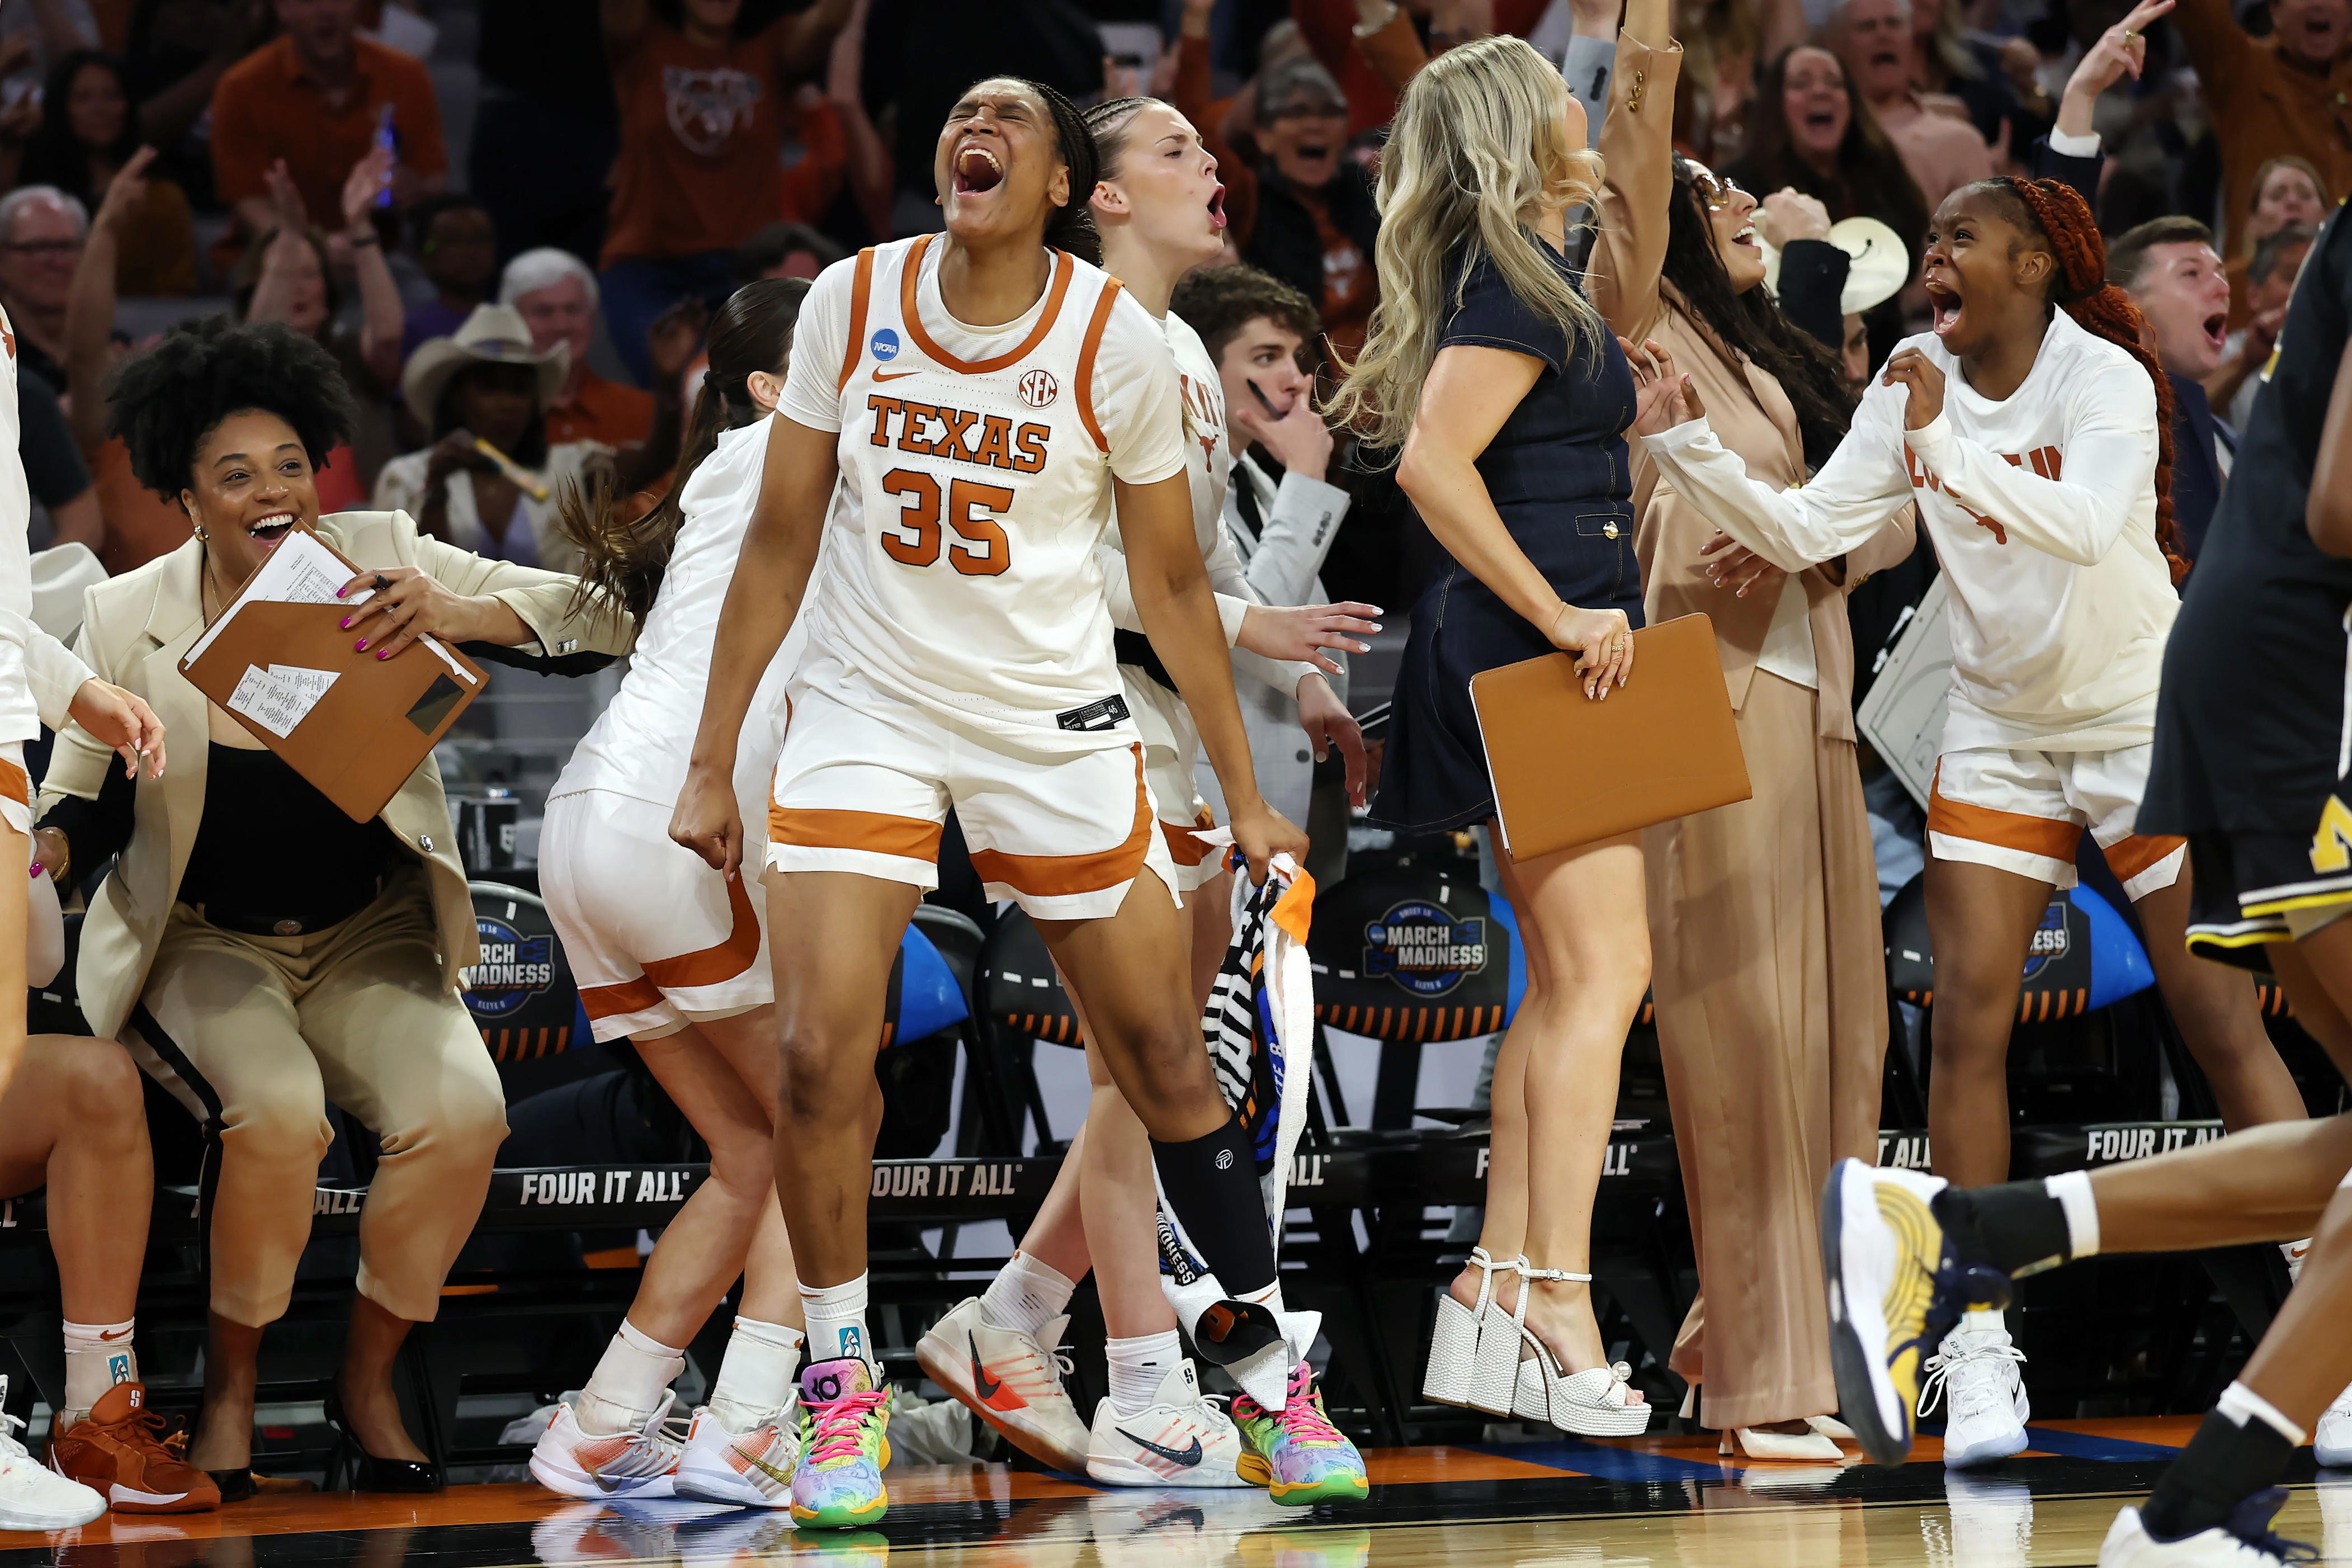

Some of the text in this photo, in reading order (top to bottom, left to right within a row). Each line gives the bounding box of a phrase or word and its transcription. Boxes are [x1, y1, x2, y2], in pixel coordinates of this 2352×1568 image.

[874, 342, 897, 353] NCAA
[1019, 370, 1057, 407] SEC
[868, 394, 1051, 474] TEXAS
[881, 467, 1014, 576] 35
[1108, 705, 1118, 714] 46
[1387, 926, 1450, 946] MARCH
[479, 943, 516, 965] RCH
[1399, 944, 1484, 966] MADNESS
[1603, 1144, 1630, 1176] LL
[1891, 1137, 1932, 1168] ALL
[2086, 1128, 2156, 1161] FOUR
[2161, 1128, 2187, 1155] IT
[521, 1173, 596, 1205] FOUR
[603, 1171, 631, 1203] IT
[871, 1165, 931, 1197] OUR
[937, 1165, 965, 1196] IT
